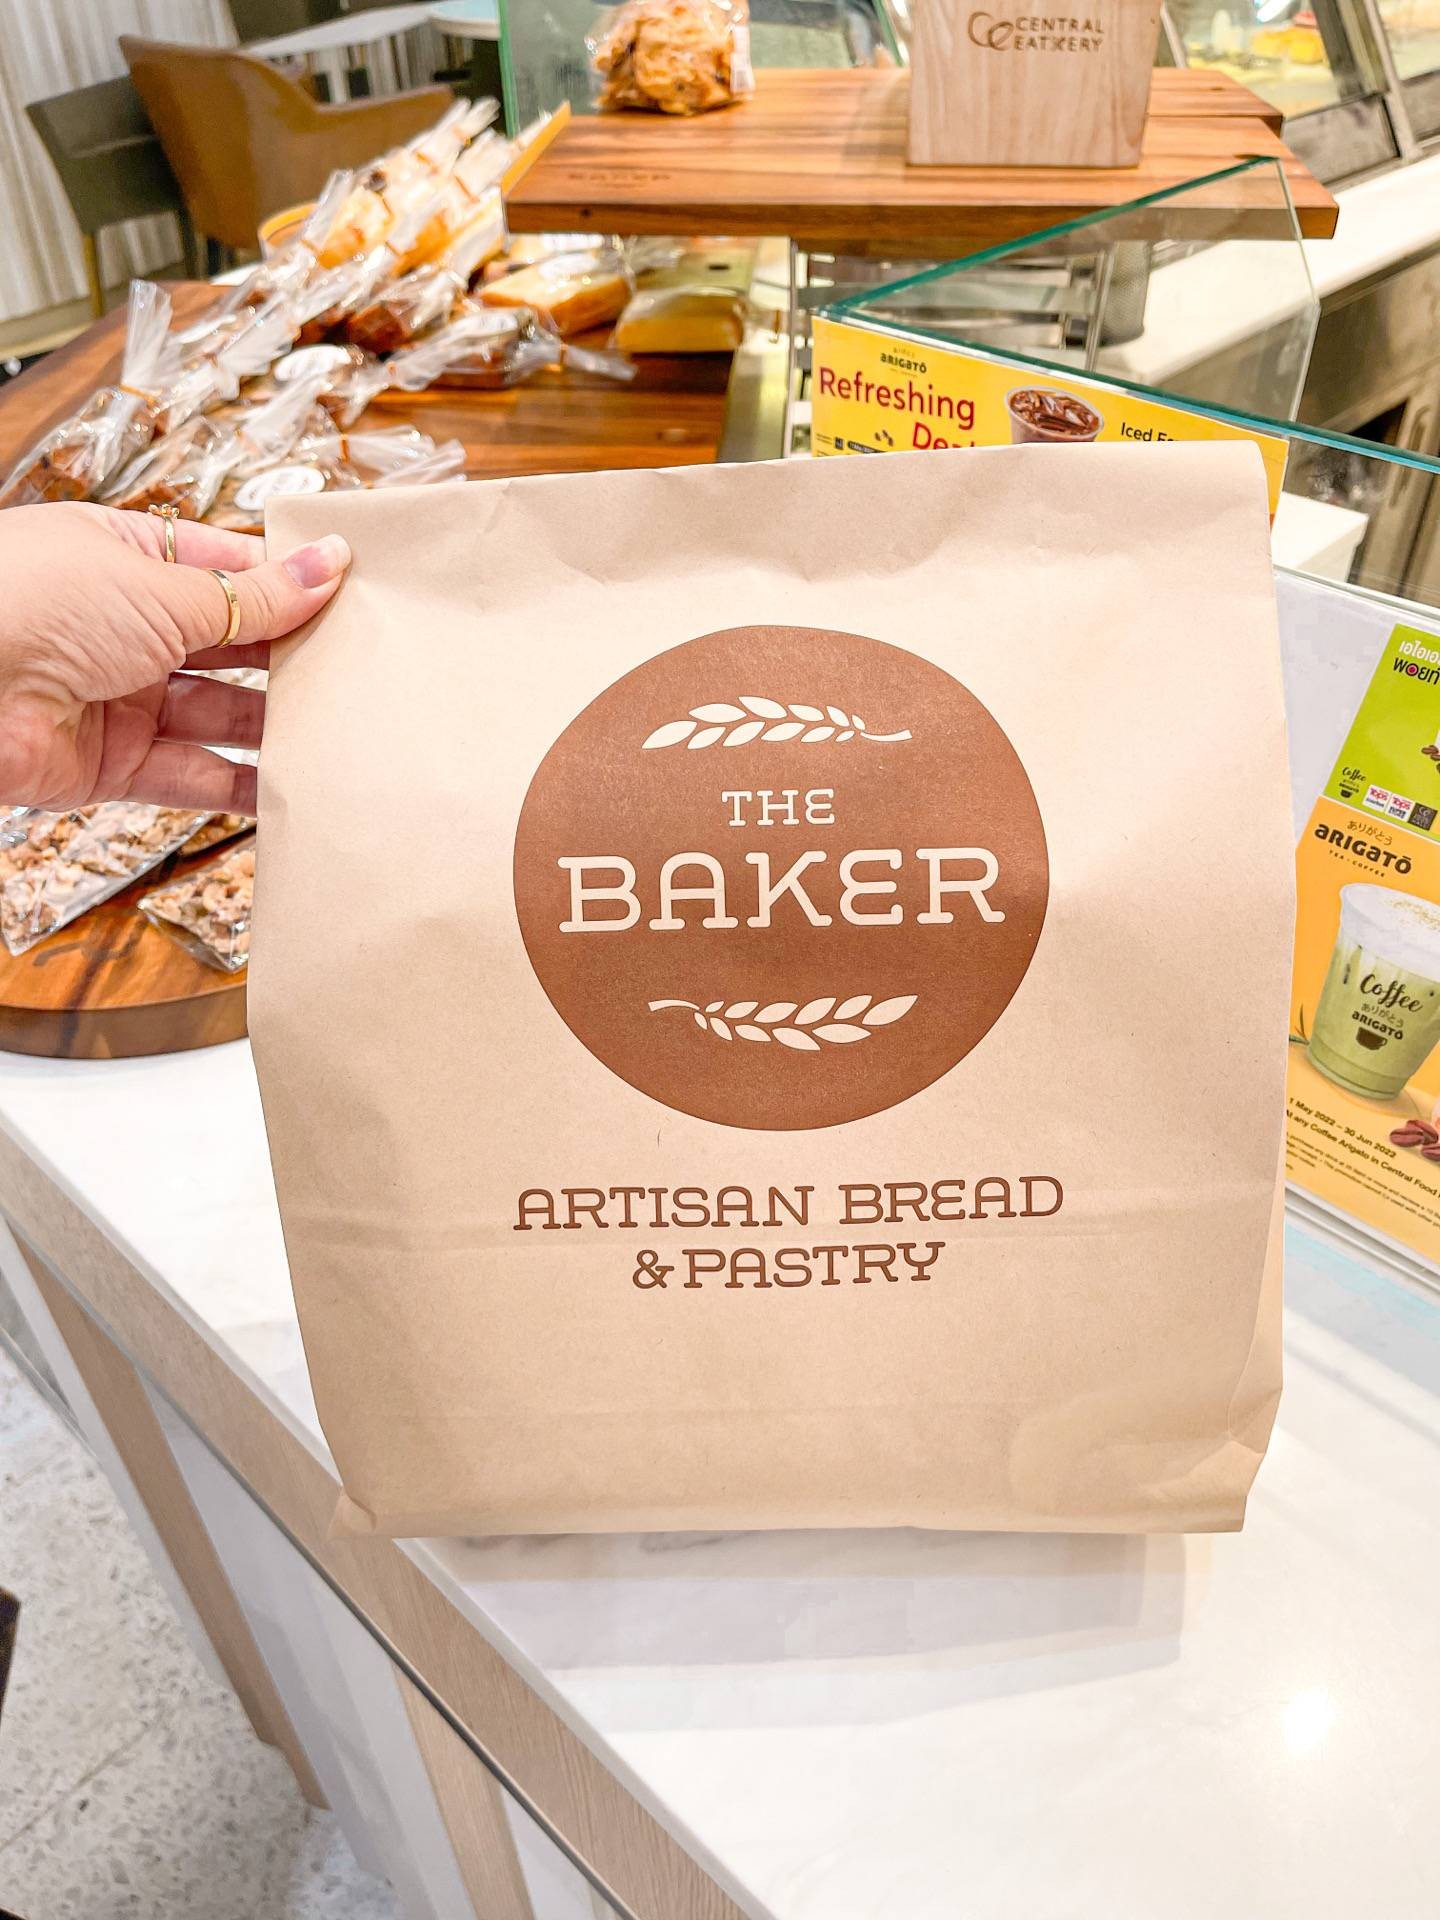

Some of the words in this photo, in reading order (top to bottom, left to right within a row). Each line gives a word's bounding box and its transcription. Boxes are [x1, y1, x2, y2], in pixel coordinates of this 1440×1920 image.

[1015, 16, 1104, 33] CENTRAL
[819, 366, 975, 430] Refreshing
[1121, 422, 1153, 441] Iced
[1393, 657, 1440, 685] พอยท
[1399, 640, 1440, 666] เอไอเอ
[721, 788, 836, 827] THE
[1347, 820, 1393, 846] ありがとう
[557, 847, 1006, 933] BAKER
[1360, 973, 1423, 1012] Coffee
[1295, 1101, 1313, 1115] May
[1314, 1110, 1336, 1126] 2022
[1344, 1126, 1356, 1137] 30
[1356, 1134, 1373, 1146] Jun
[1373, 1142, 1397, 1158] 2022
[1294, 1116, 1309, 1128] any
[1310, 1123, 1338, 1142] Coffee
[1338, 1139, 1370, 1159] Arigato
[1371, 1155, 1380, 1165] in
[1381, 1161, 1414, 1182] Central
[1414, 1179, 1438, 1196] Food
[513, 1186, 815, 1231] ARTISAN
[838, 1175, 1064, 1224] BREAD
